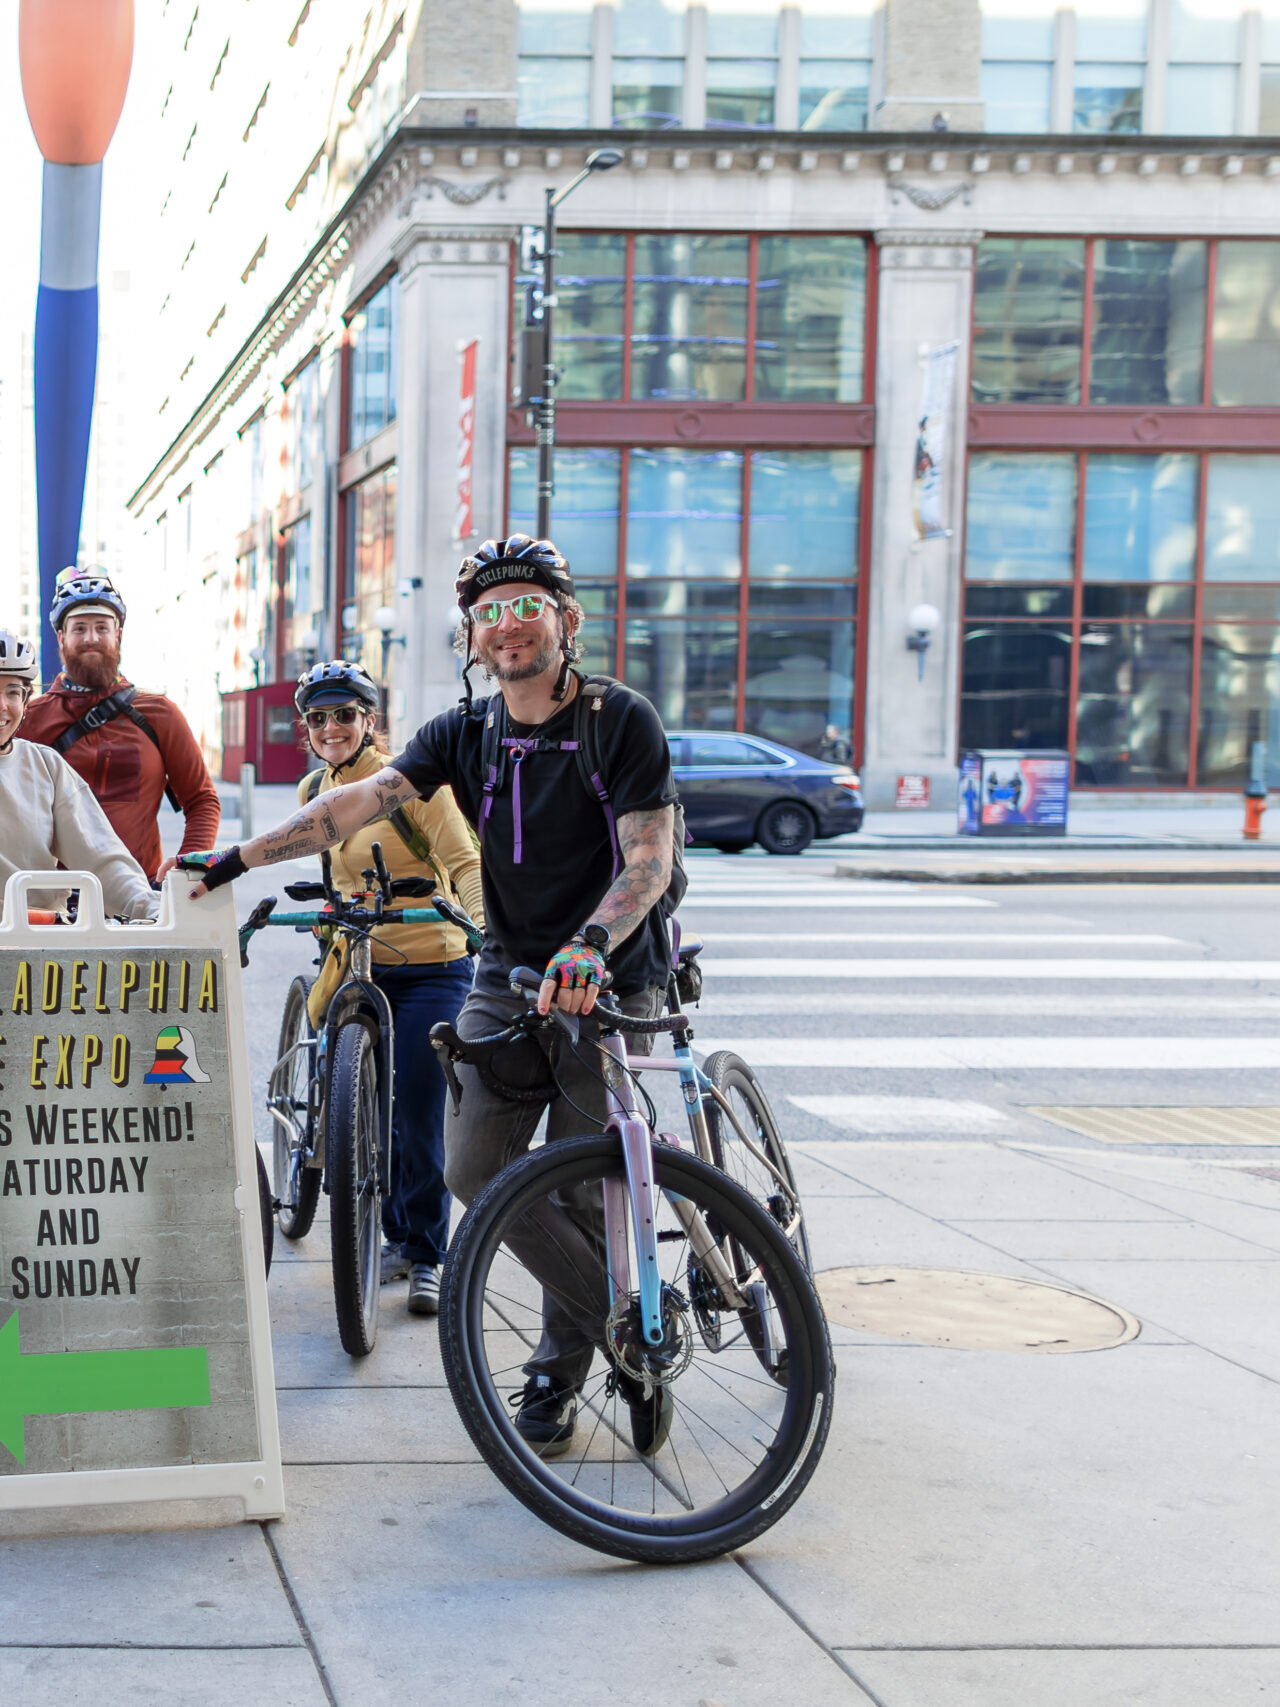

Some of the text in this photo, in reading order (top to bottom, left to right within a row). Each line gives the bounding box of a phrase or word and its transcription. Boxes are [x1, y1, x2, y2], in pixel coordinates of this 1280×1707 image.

[476, 564, 536, 588] CYCLEPUNKS
[30, 1033, 130, 1090] EXPO
[36, 1208, 101, 1247] AND
